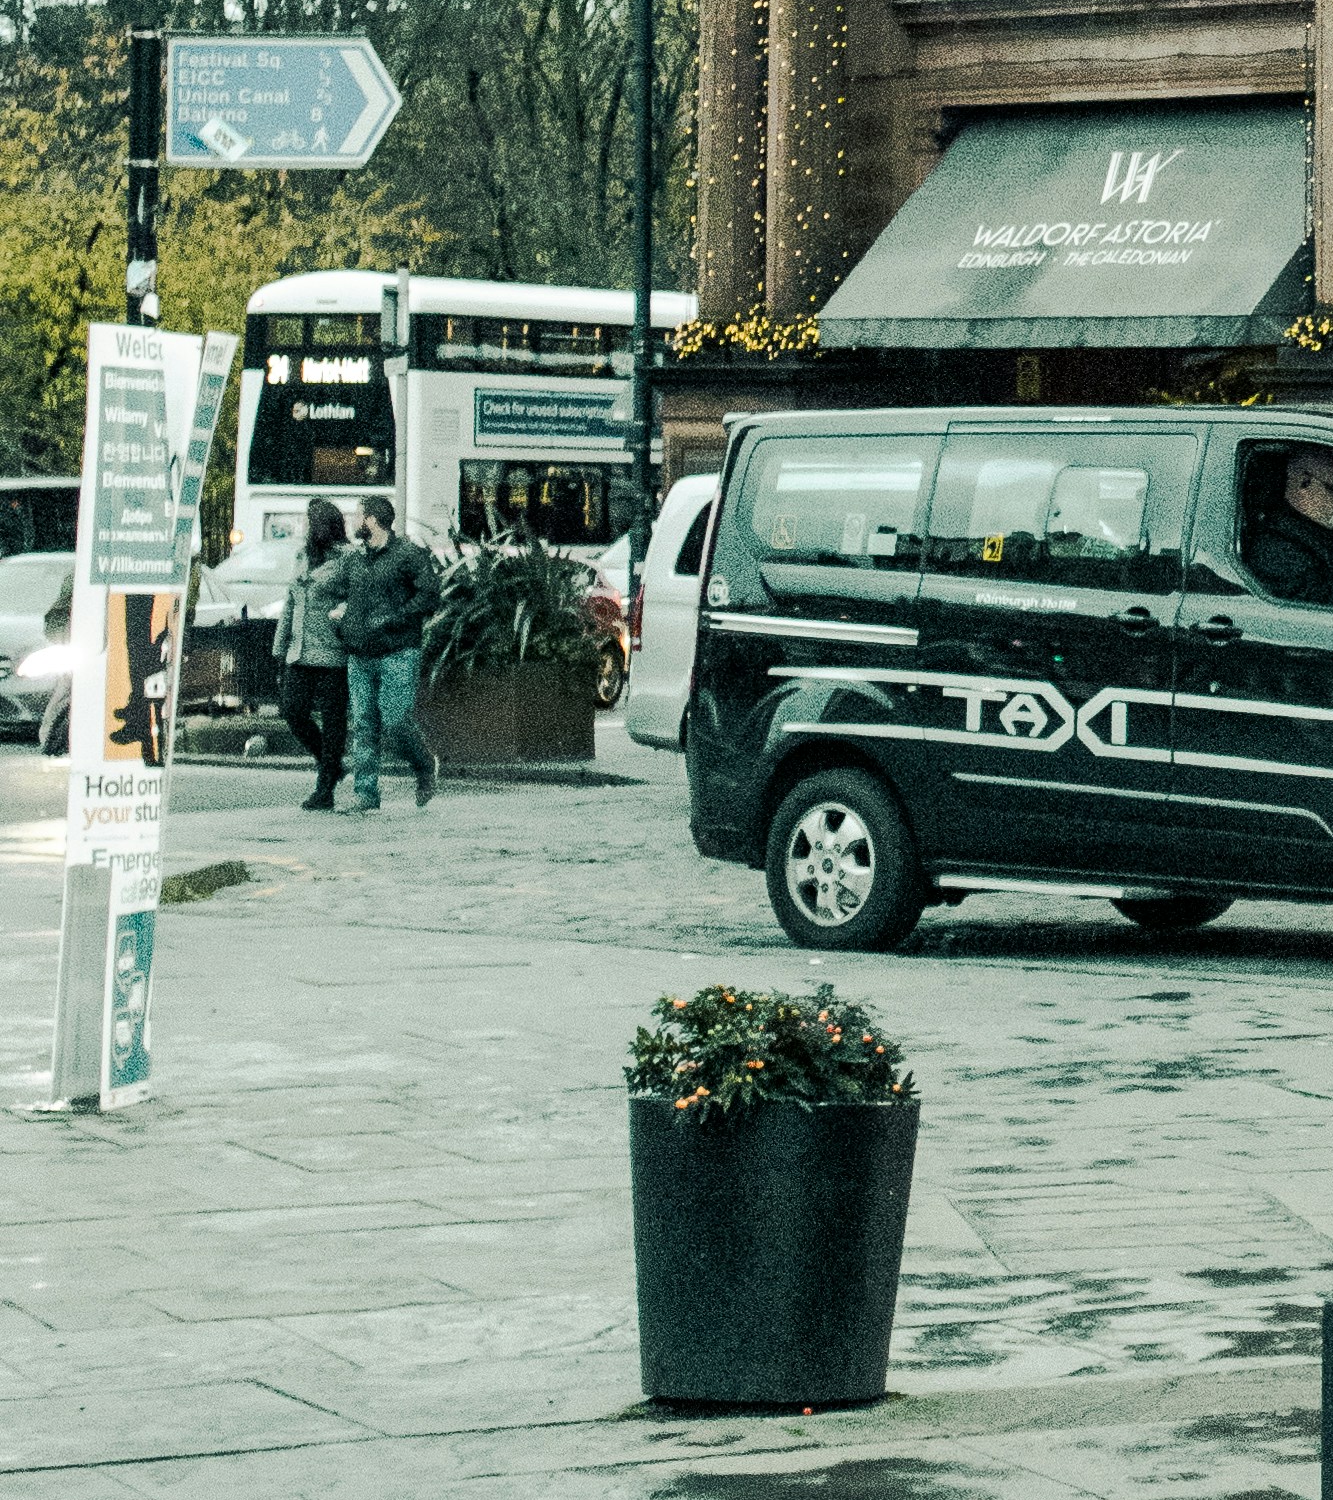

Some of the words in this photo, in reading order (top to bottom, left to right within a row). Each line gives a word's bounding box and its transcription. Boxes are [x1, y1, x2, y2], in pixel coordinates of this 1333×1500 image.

[178, 50, 248, 68] Festival
[256, 50, 282, 74] Sq
[178, 70, 226, 86] EICC
[178, 88, 230, 104] Union
[238, 88, 290, 105] Canal
[178, 107, 248, 122] Balerno
[971, 222, 1106, 248] WALDORF
[1099, 219, 1214, 246] ASTORIA
[957, 252, 1047, 269] EDINBURGH
[1063, 251, 1094, 268] THE
[1090, 249, 1194, 267] CALEDONIAN
[115, 332, 163, 360] Welc
[309, 402, 355, 420] Lothian
[942, 682, 1128, 755] TAXI
[85, 774, 134, 797] Hold
[82, 806, 132, 831] your
[92, 849, 161, 874] Emerge
